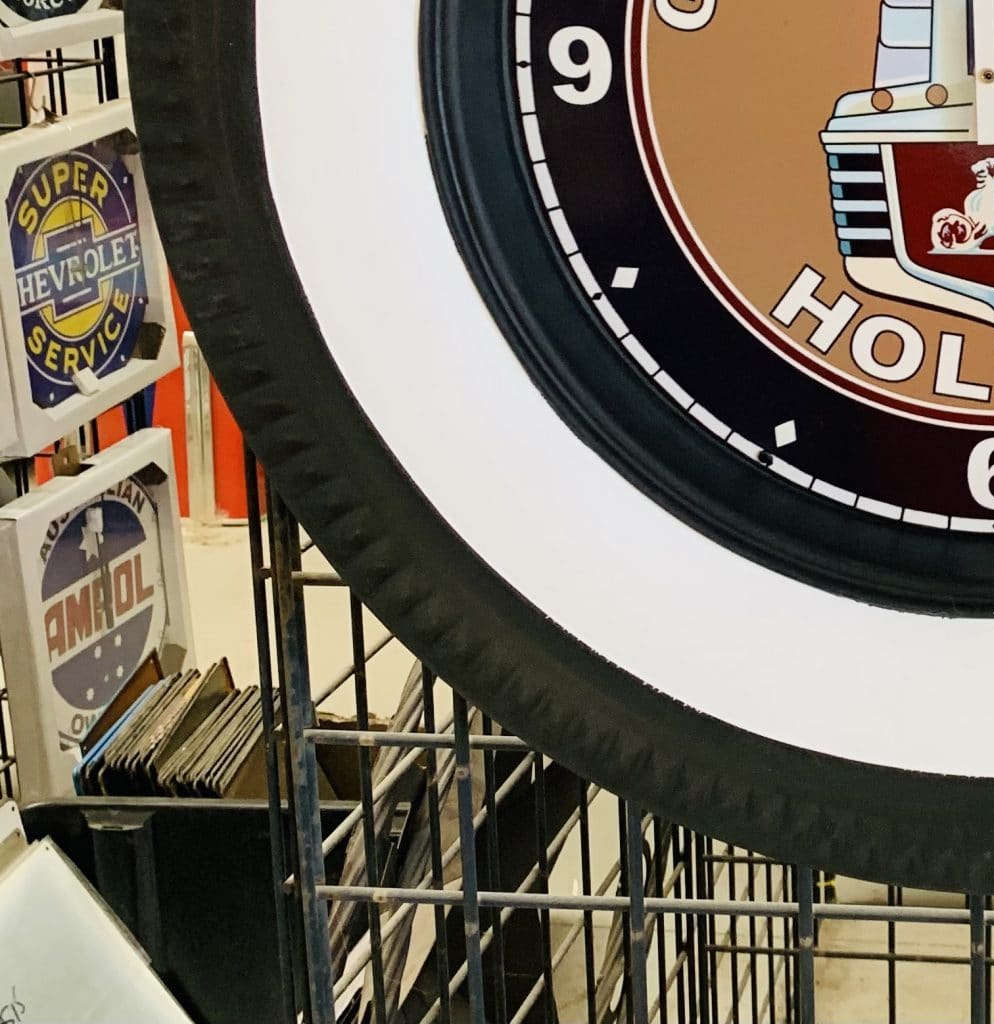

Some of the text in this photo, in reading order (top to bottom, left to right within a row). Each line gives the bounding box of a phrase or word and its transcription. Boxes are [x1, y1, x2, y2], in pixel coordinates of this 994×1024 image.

[548, 26, 612, 105] 9
[18, 161, 109, 235] SUPER
[17, 229, 140, 307] HEVROLET
[28, 288, 130, 376] SERVICE
